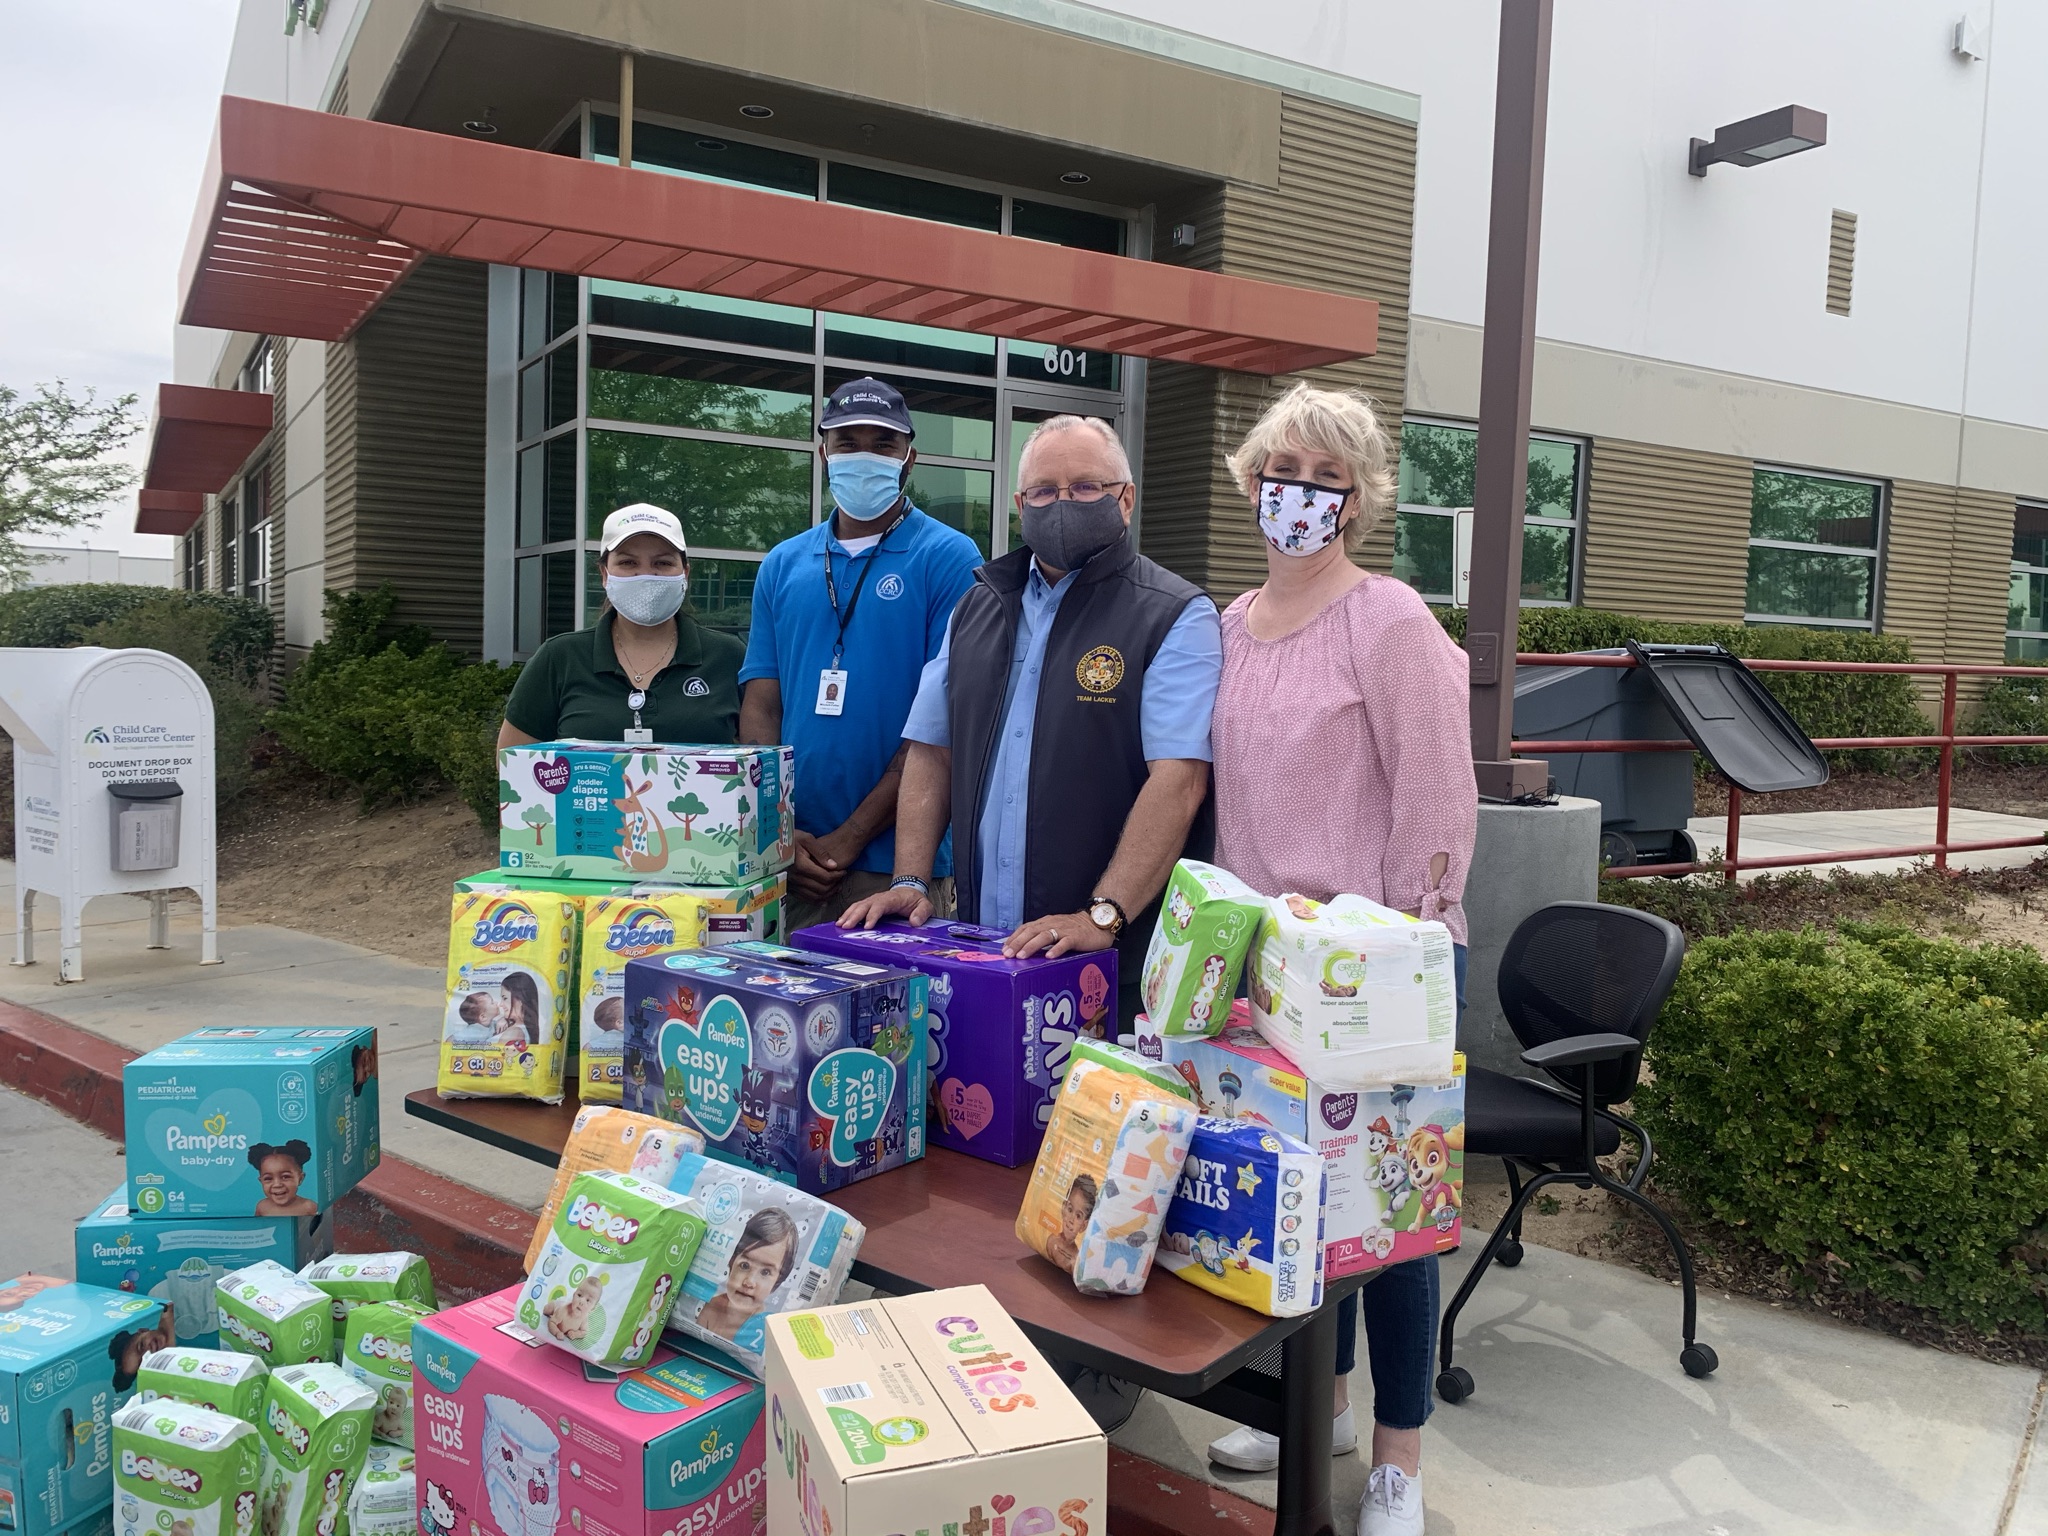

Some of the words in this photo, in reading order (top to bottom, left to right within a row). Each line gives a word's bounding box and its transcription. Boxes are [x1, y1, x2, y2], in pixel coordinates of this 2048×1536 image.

[1044, 348, 1086, 378] 601
[878, 588, 899, 597] CCRC
[112, 726, 140, 734] Child
[142, 725, 166, 733] Care
[114, 734, 160, 743] Resource
[163, 734, 195, 742] Center
[89, 760, 142, 769] DOCUMENT
[145, 759, 170, 767] DROP
[102, 770, 116, 778] DO
[119, 769, 143, 777] NOT
[141, 768, 180, 776] DEPOSIT
[538, 764, 568, 779] Parent's
[545, 777, 566, 787] CHOICE
[572, 786, 608, 795] diapers
[587, 801, 594, 810] 6
[508, 852, 520, 867] 6
[744, 863, 749, 874] 6
[1217, 929, 1229, 939] P
[1228, 914, 1238, 924] 22
[490, 943, 511, 952] super
[1297, 938, 1304, 951] 66
[1318, 938, 1329, 946] 66
[624, 948, 648, 957] super
[1084, 994, 1092, 1005] 5
[1184, 956, 1226, 1031] Bebex
[1023, 998, 1035, 1044] level
[707, 1022, 745, 1049] Pampers
[1320, 1031, 1329, 1049] 1
[1141, 1042, 1161, 1054] Parent's
[454, 1060, 463, 1073] 2
[468, 1058, 485, 1070] CH
[488, 1060, 503, 1070] 40
[677, 1044, 728, 1080] easy
[1025, 1046, 1037, 1078] pro
[591, 1068, 601, 1080] 2
[607, 1064, 623, 1077] CH
[138, 1086, 196, 1094] PEDIATRICIAN
[689, 1074, 729, 1104] ups
[827, 1060, 839, 1108] Pampers
[1073, 1072, 1080, 1082] 20
[1114, 1093, 1120, 1105] 5
[1269, 1076, 1285, 1087] super
[1284, 1081, 1301, 1094] value
[861, 1068, 879, 1120] ups
[955, 1087, 964, 1105] 5
[700, 1103, 722, 1117] training
[844, 1077, 861, 1140] easy
[1326, 1093, 1355, 1116] Parent's
[695, 1109, 726, 1125] underwear
[913, 1108, 919, 1122] 76
[950, 1108, 965, 1122] 124
[1140, 1109, 1149, 1121] 5
[1332, 1108, 1352, 1123] CHOICE
[343, 1094, 352, 1165] Pampers
[627, 1127, 633, 1136] 5
[167, 1126, 246, 1154] Pampers
[654, 1139, 662, 1150] 5
[1320, 1134, 1358, 1150] Training
[181, 1156, 235, 1166] baby-dry
[145, 1190, 157, 1204] 6
[168, 1191, 185, 1202] 64
[567, 1195, 640, 1246] Bebex
[670, 1245, 680, 1256] P
[681, 1227, 689, 1238] 22
[705, 1229, 734, 1248] NEST
[92, 1243, 144, 1258] Pampers
[588, 1238, 613, 1254] Babysec
[613, 1249, 626, 1260] Plus
[1339, 1243, 1353, 1254] 70
[101, 1258, 136, 1266] baby-dry
[1279, 1262, 1290, 1302] TAILS
[524, 1306, 530, 1315] P
[621, 1274, 672, 1361] Bebex
[660, 1295, 675, 1325] Babysec
[0, 1312, 72, 1335] Pampers
[218, 1307, 273, 1353] Bebex
[305, 1320, 314, 1330] 22
[302, 1336, 313, 1347] P
[751, 1329, 763, 1348] 2
[426, 1353, 456, 1384] Pampers
[935, 1316, 1036, 1413] cuties
[656, 1369, 707, 1396] Rewards
[676, 1370, 706, 1385] Pampers
[946, 1365, 974, 1397] complete
[969, 1397, 987, 1415] care
[424, 1393, 464, 1429] easy
[266, 1399, 310, 1455] Bebex
[841, 1419, 858, 1428] 2
[86, 1392, 110, 1477] Pampers
[334, 1443, 345, 1453] P
[342, 1424, 351, 1435] 22
[430, 1420, 463, 1450] ups
[846, 1428, 872, 1449] 204
[427, 1444, 445, 1460] training
[444, 1451, 471, 1466] underwear
[121, 1449, 202, 1493] Bebex
[240, 1467, 250, 1477] P
[670, 1442, 733, 1488] Pampers
[47, 1468, 58, 1526] PEDIATRICIAN
[160, 1488, 186, 1502] Babysec
[715, 1494, 757, 1529] underwear
